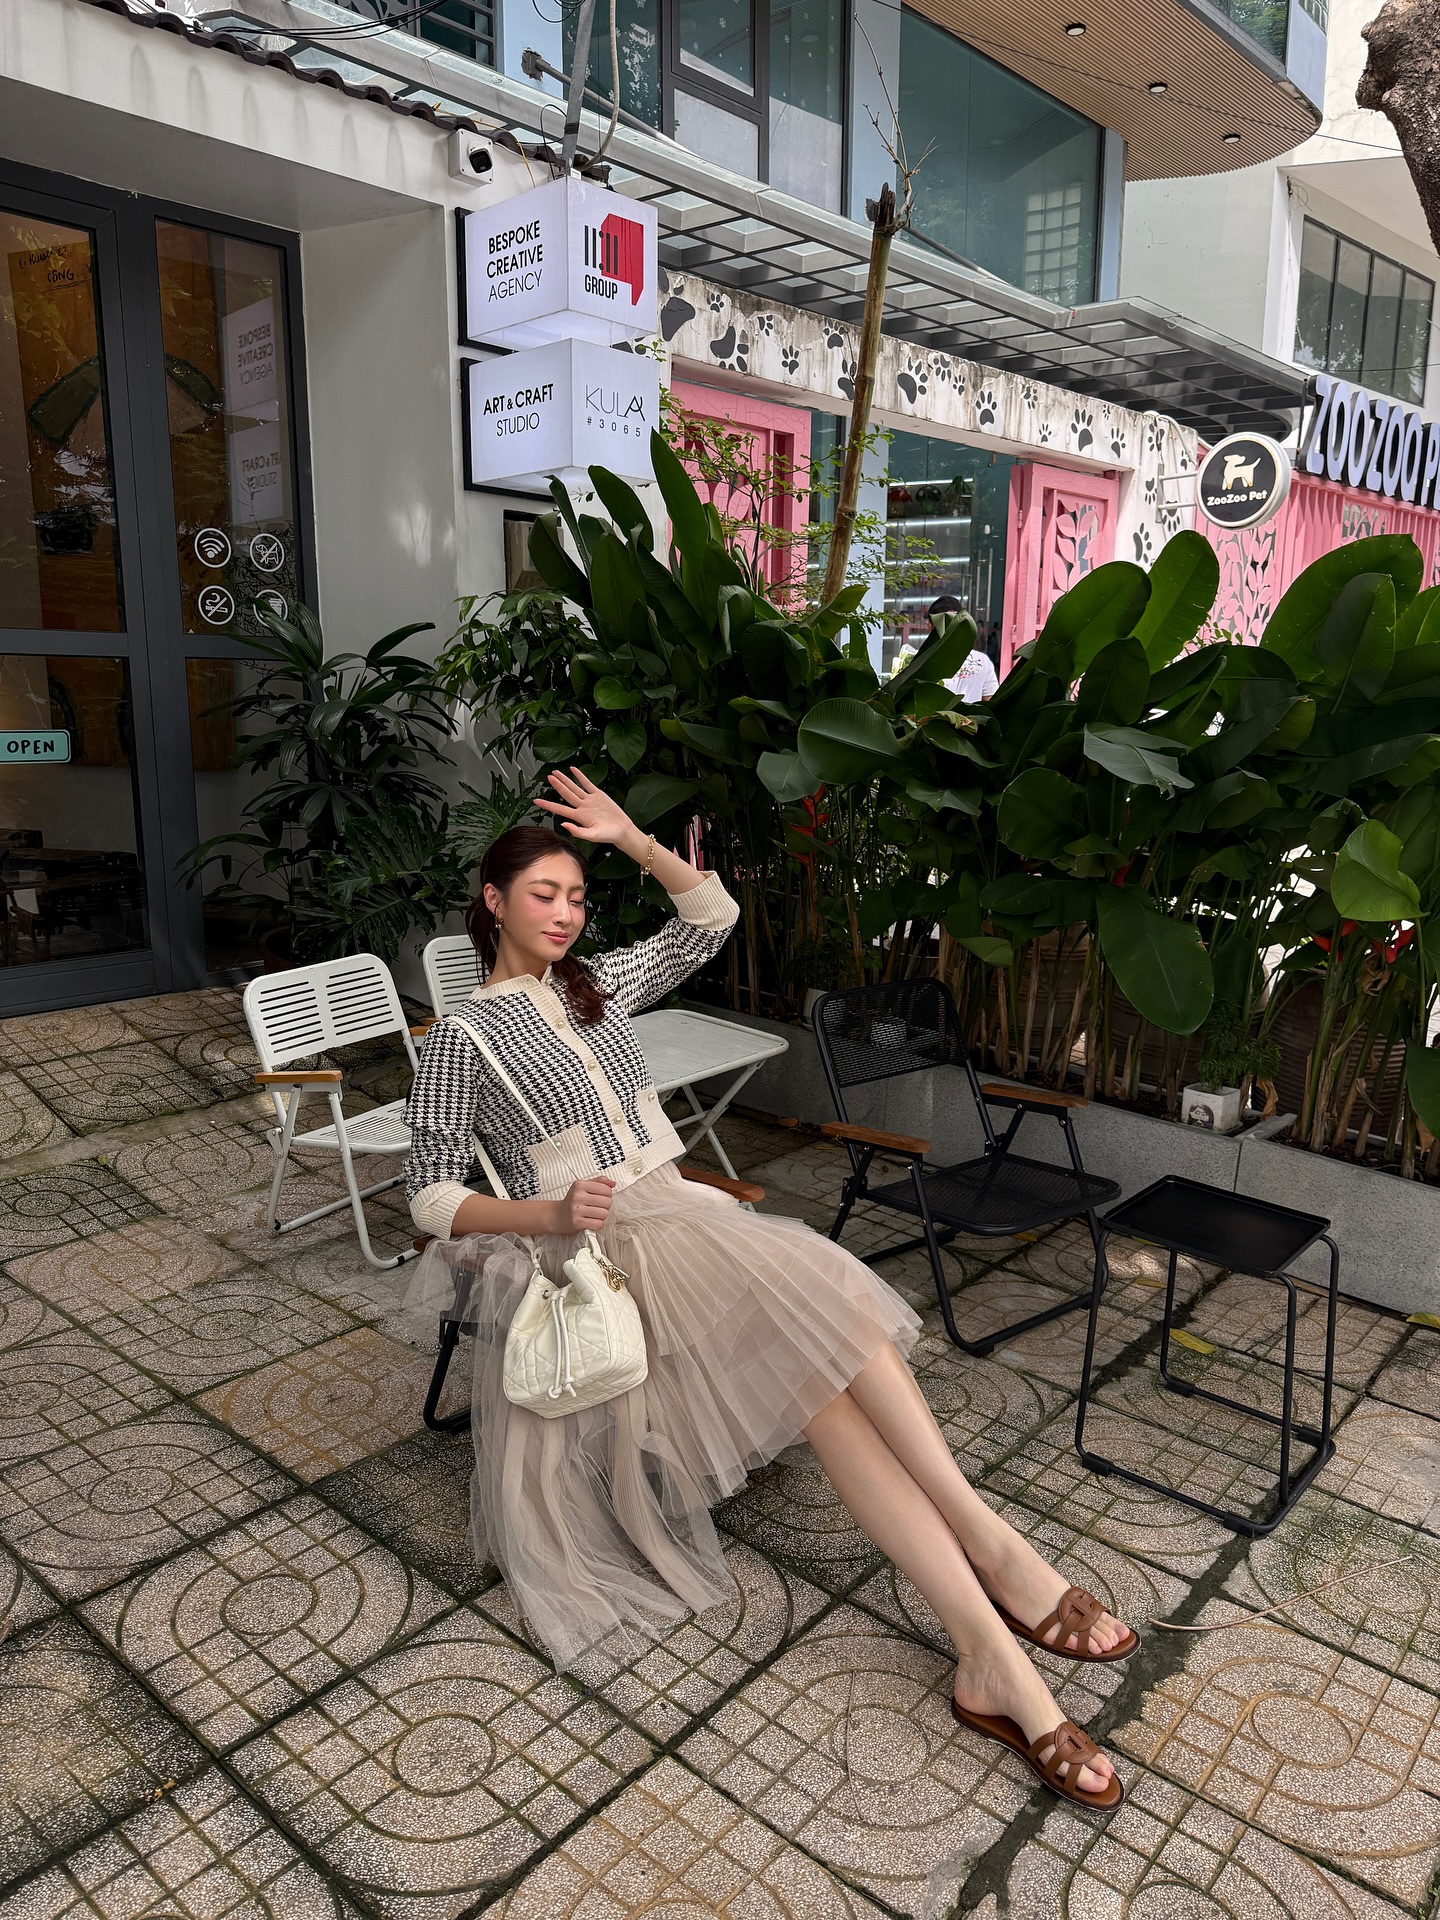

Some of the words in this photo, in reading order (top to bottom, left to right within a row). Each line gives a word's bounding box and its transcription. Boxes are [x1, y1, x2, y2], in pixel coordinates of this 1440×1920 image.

[488, 219, 541, 255] BESPOKE
[486, 243, 544, 279] CREATIVE
[488, 268, 543, 303] AGENCY
[584, 273, 619, 300] GROUP
[483, 394, 506, 416] ART
[507, 397, 514, 411] &
[515, 382, 554, 408] CRAFT
[496, 412, 540, 437] STUDIO
[1304, 374, 1423, 502] ZOOZOO
[1206, 494, 1248, 506] ZooZoo
[1249, 489, 1268, 501] Pet
[6, 739, 55, 755] OPEN
